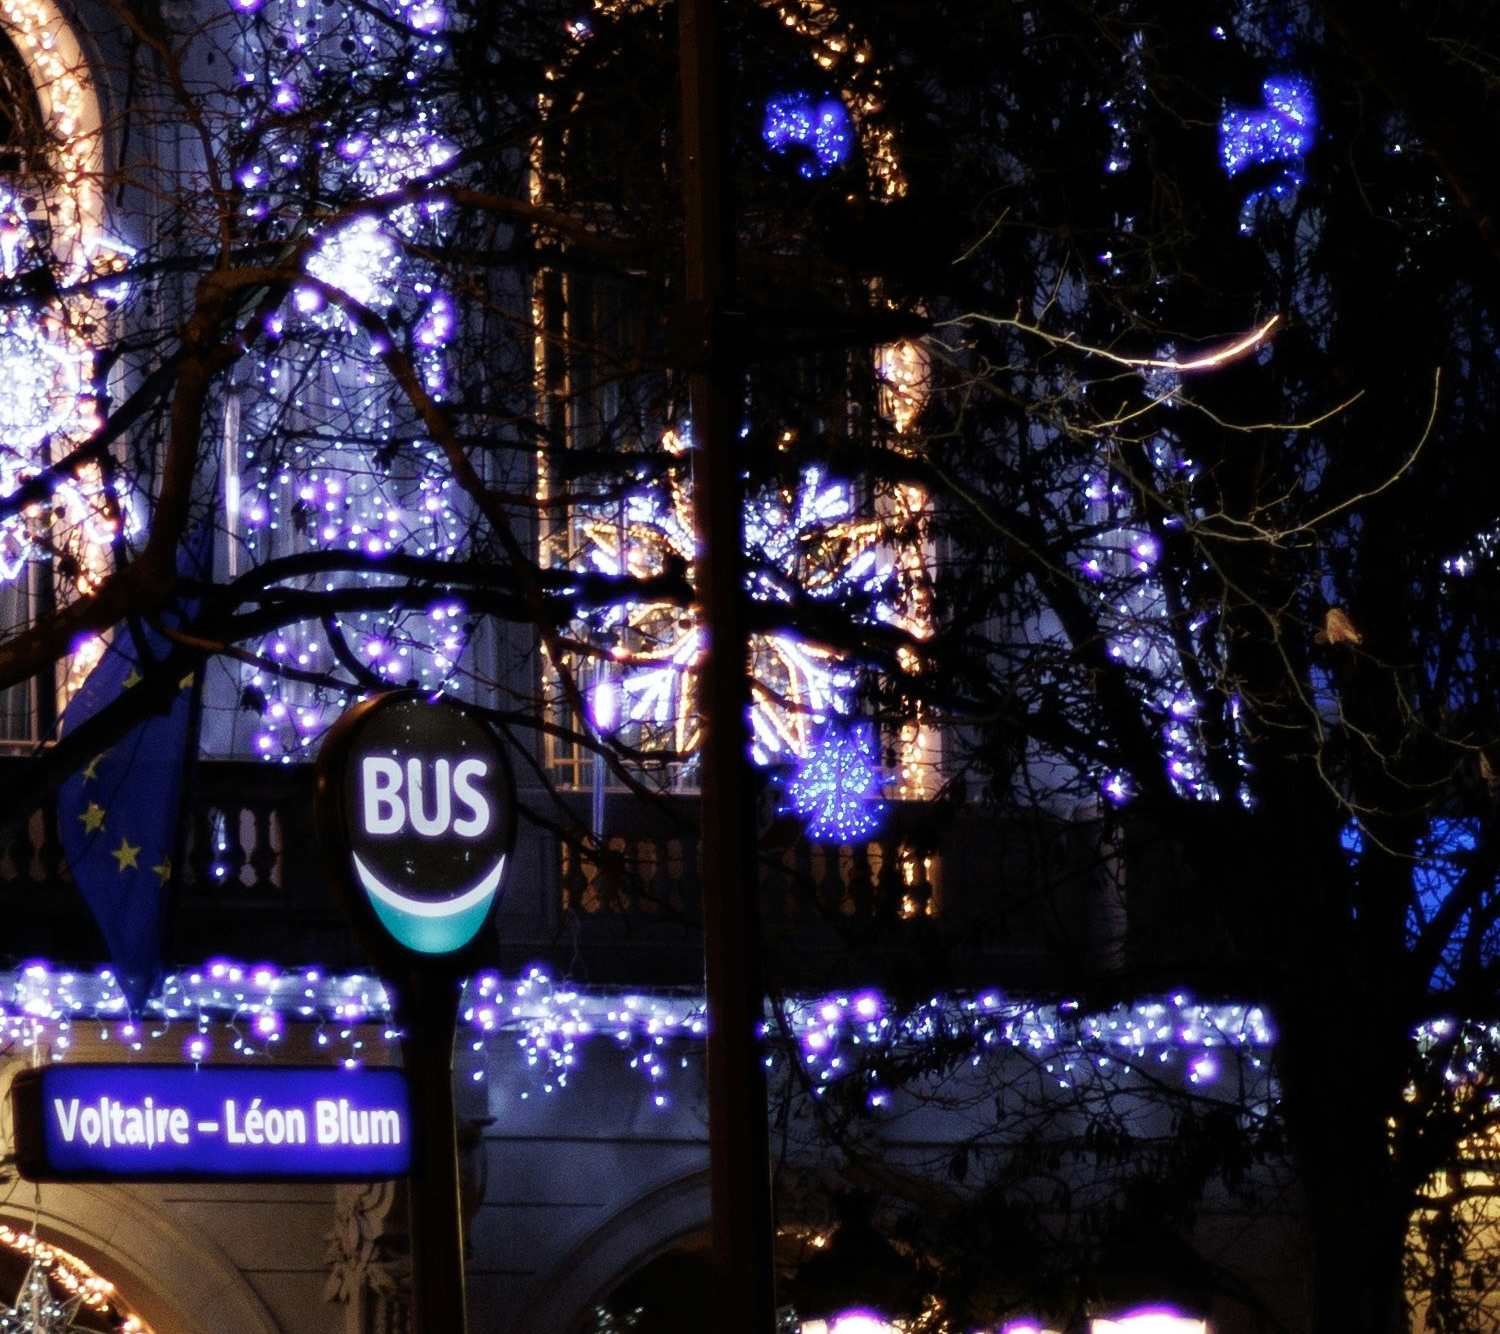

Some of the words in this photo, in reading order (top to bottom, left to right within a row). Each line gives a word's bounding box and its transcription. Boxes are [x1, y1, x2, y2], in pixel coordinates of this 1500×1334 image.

[362, 756, 490, 837] BUS
[54, 1097, 189, 1147] Voltaire
[225, 1098, 306, 1145] Léon
[315, 1098, 401, 1145] Blum
